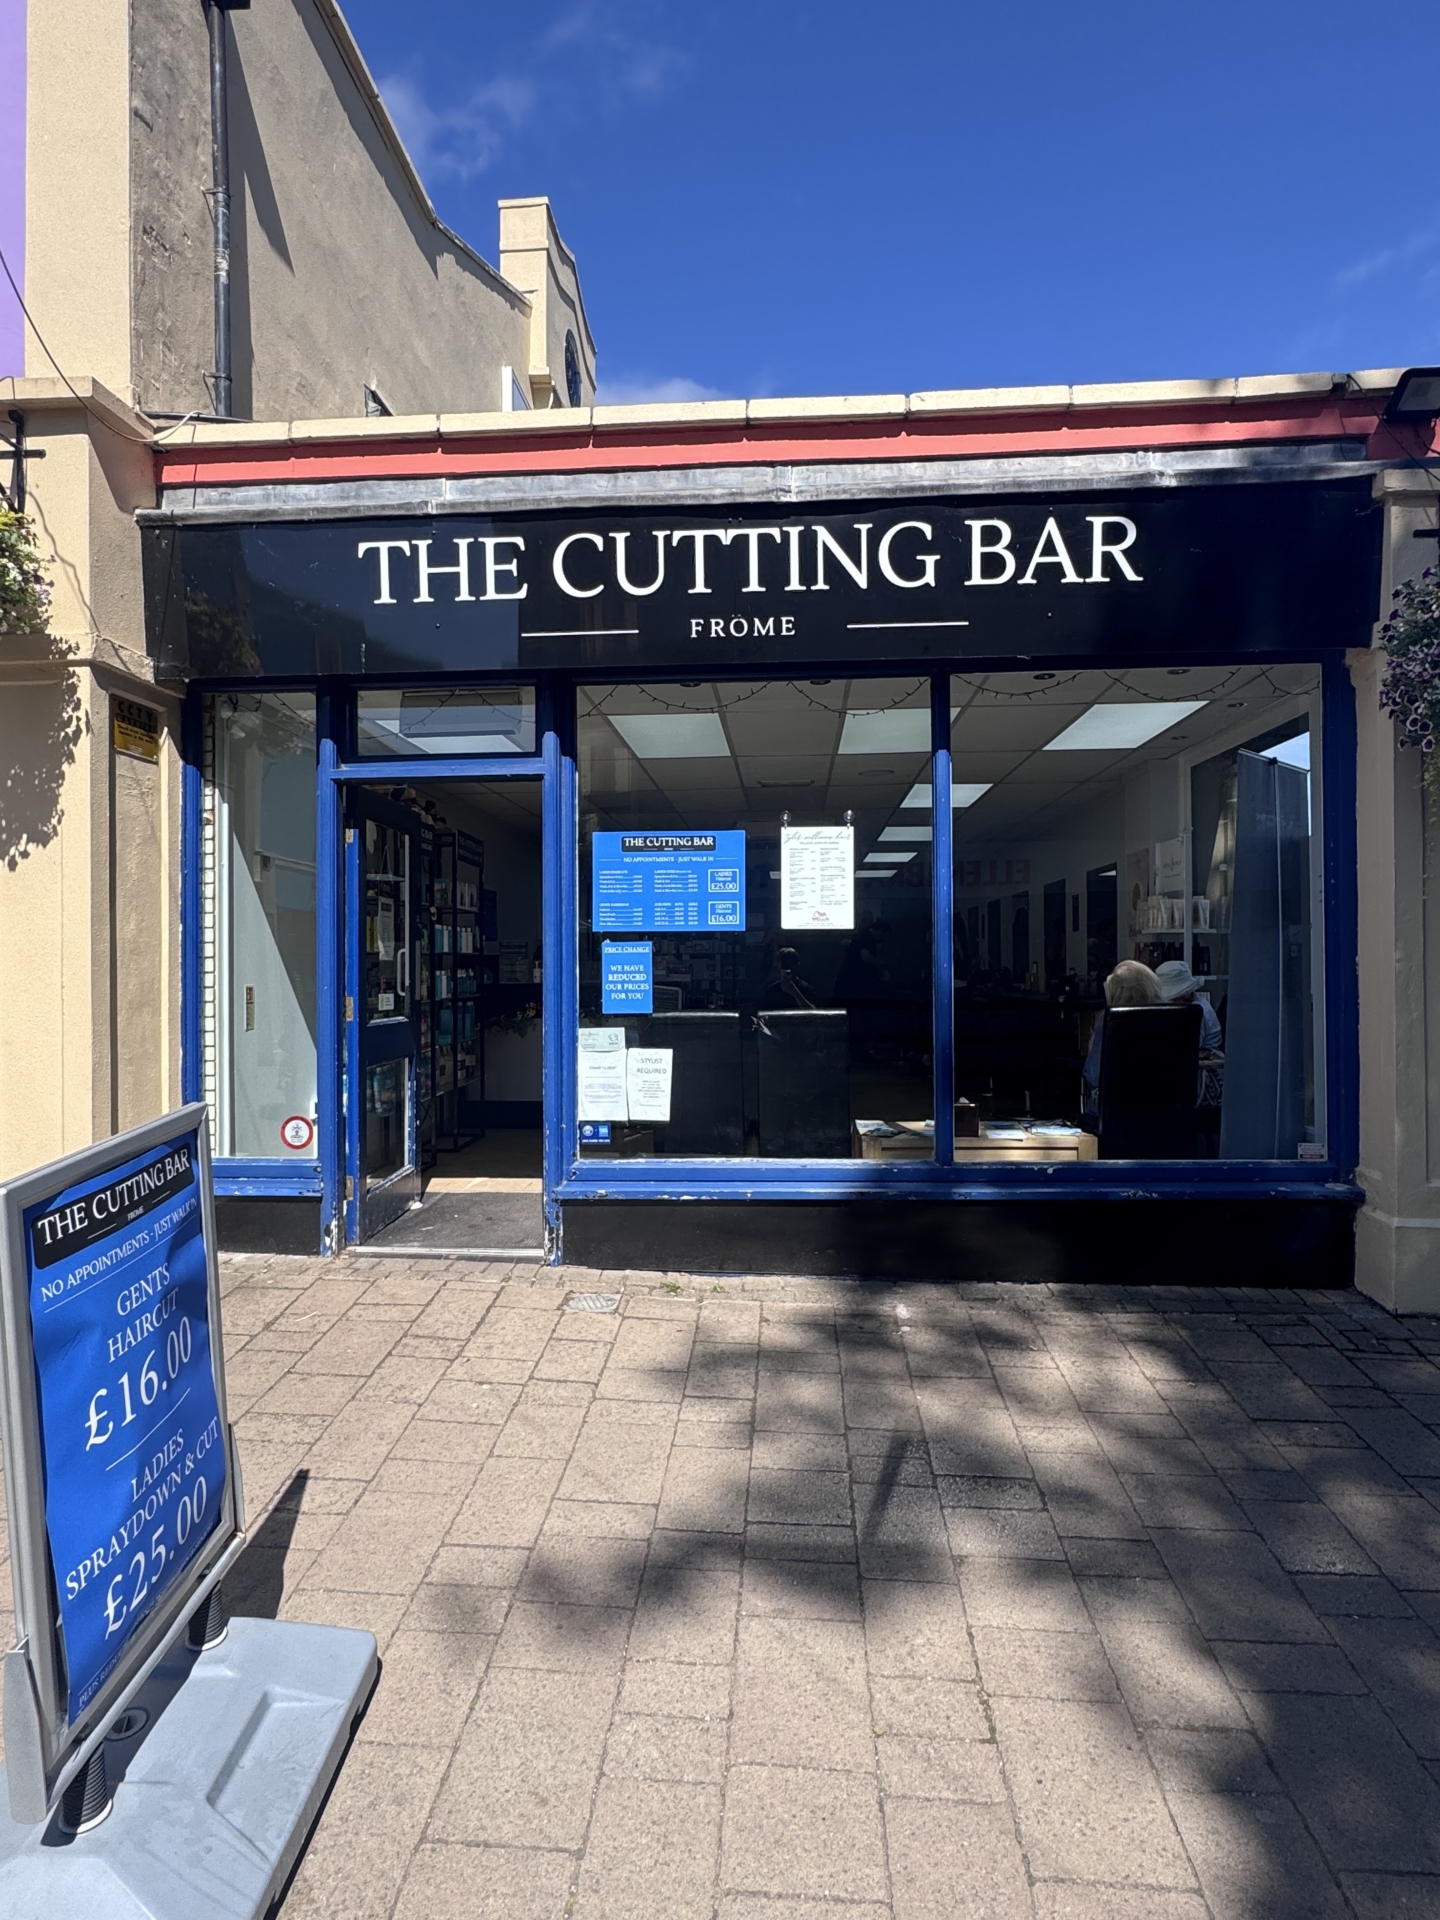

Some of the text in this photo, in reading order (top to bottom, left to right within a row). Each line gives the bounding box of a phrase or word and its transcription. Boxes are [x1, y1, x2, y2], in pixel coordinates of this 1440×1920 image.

[358, 516, 1144, 604] THE CUTTING BAR
[690, 616, 796, 638] FROME
[623, 836, 714, 847] THE CUTTING BAR
[711, 882, 737, 890] £25.00
[711, 914, 737, 922] £16.00
[605, 983, 650, 991] OUR PRICES
[608, 973, 647, 981] REDUCED
[610, 964, 645, 972] WE HAVE
[611, 992, 644, 1000] FOR YOU
[636, 1067, 667, 1075] REQUIRED
[37, 1148, 190, 1246] THE CUTTING BAR
[40, 1279, 64, 1303] NO
[66, 1230, 150, 1290] APPOINTMENTS
[154, 1214, 172, 1242] JUST
[171, 1200, 191, 1224] WALK
[117, 1262, 170, 1316] GENTS
[107, 1287, 179, 1363] HAIRCUT
[84, 1316, 192, 1452] £16.00
[131, 1428, 184, 1503] LADIES
[65, 1464, 182, 1601] SPRAYDOWN
[184, 1452, 195, 1476] &
[196, 1416, 218, 1460] CUT
[103, 1475, 207, 1640] £25.00
